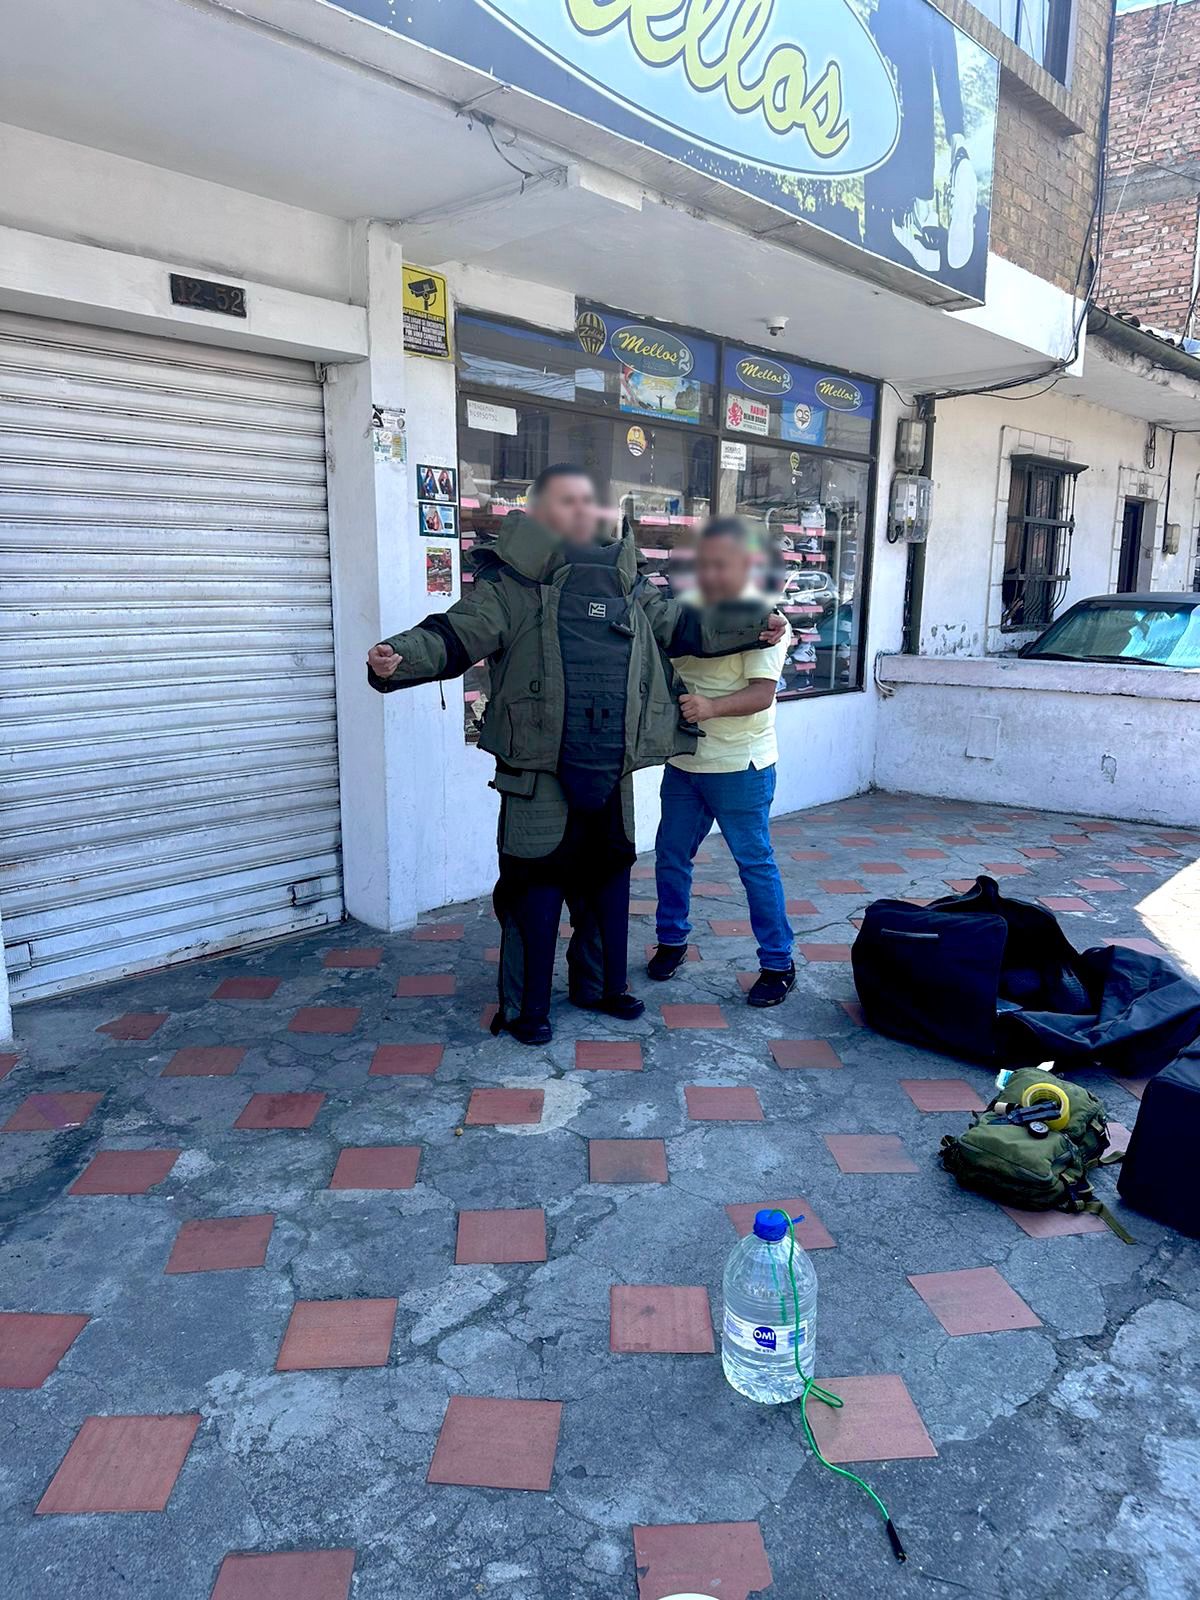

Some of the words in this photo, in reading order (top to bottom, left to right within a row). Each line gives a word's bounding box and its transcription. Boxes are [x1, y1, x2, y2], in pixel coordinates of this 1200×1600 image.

[566, 0, 850, 159] ellos
[177, 280, 244, 313] 12-52
[619, 332, 678, 365] Mellos
[741, 362, 782, 383] Mellos
[820, 382, 853, 401] Mellos
[754, 1330, 775, 1340] OMI
